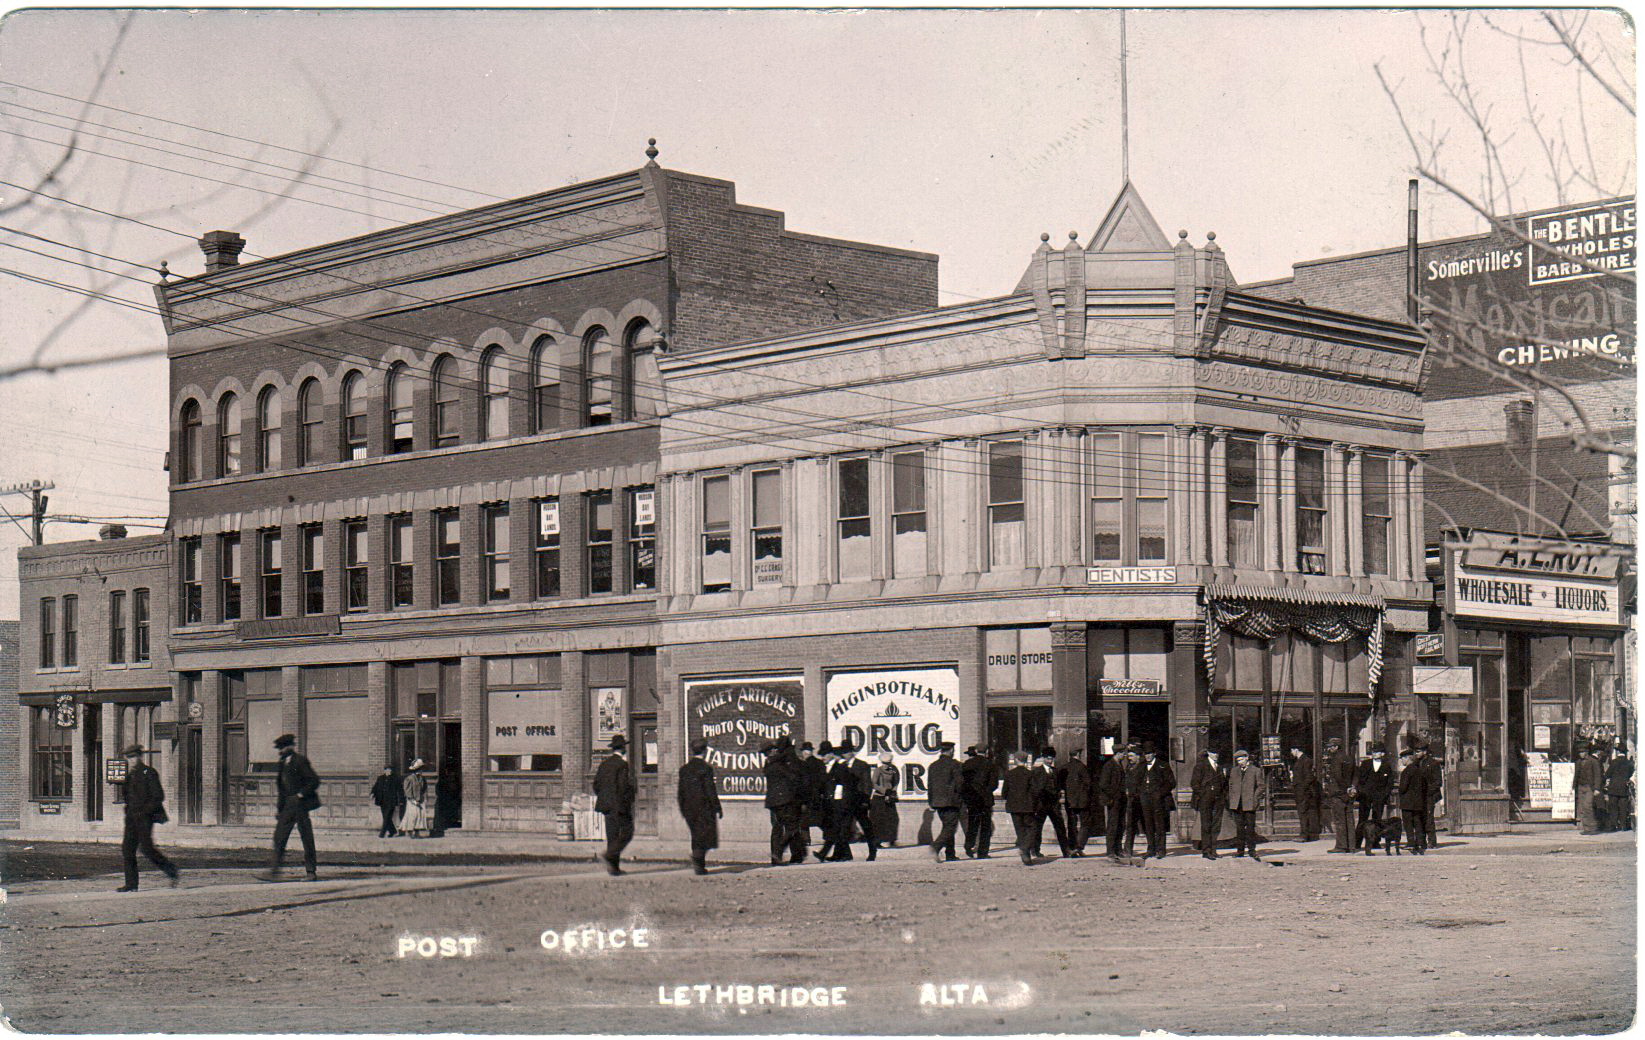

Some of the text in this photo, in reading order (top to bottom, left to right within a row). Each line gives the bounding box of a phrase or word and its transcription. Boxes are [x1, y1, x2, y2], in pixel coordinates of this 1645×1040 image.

[1534, 207, 1636, 243] THE BENTLE
[1556, 235, 1636, 257] WHOLES
[1427, 250, 1523, 281] Somerville's
[1497, 333, 1620, 366] CHEWING
[1089, 568, 1175, 583] DENTISTS
[1458, 578, 1610, 611] WHOLESALE LIQUORS.
[988, 652, 1053, 666] DRUG STORE
[696, 687, 796, 718] TOILET ARTICLES
[831, 680, 960, 720] HIGINBOTHAM'S
[495, 725, 556, 736] POST OFFICE
[702, 720, 734, 738] PHOTO
[841, 722, 943, 756] DRUG
[704, 746, 768, 770] TATION
[723, 776, 768, 793] CHOCO
